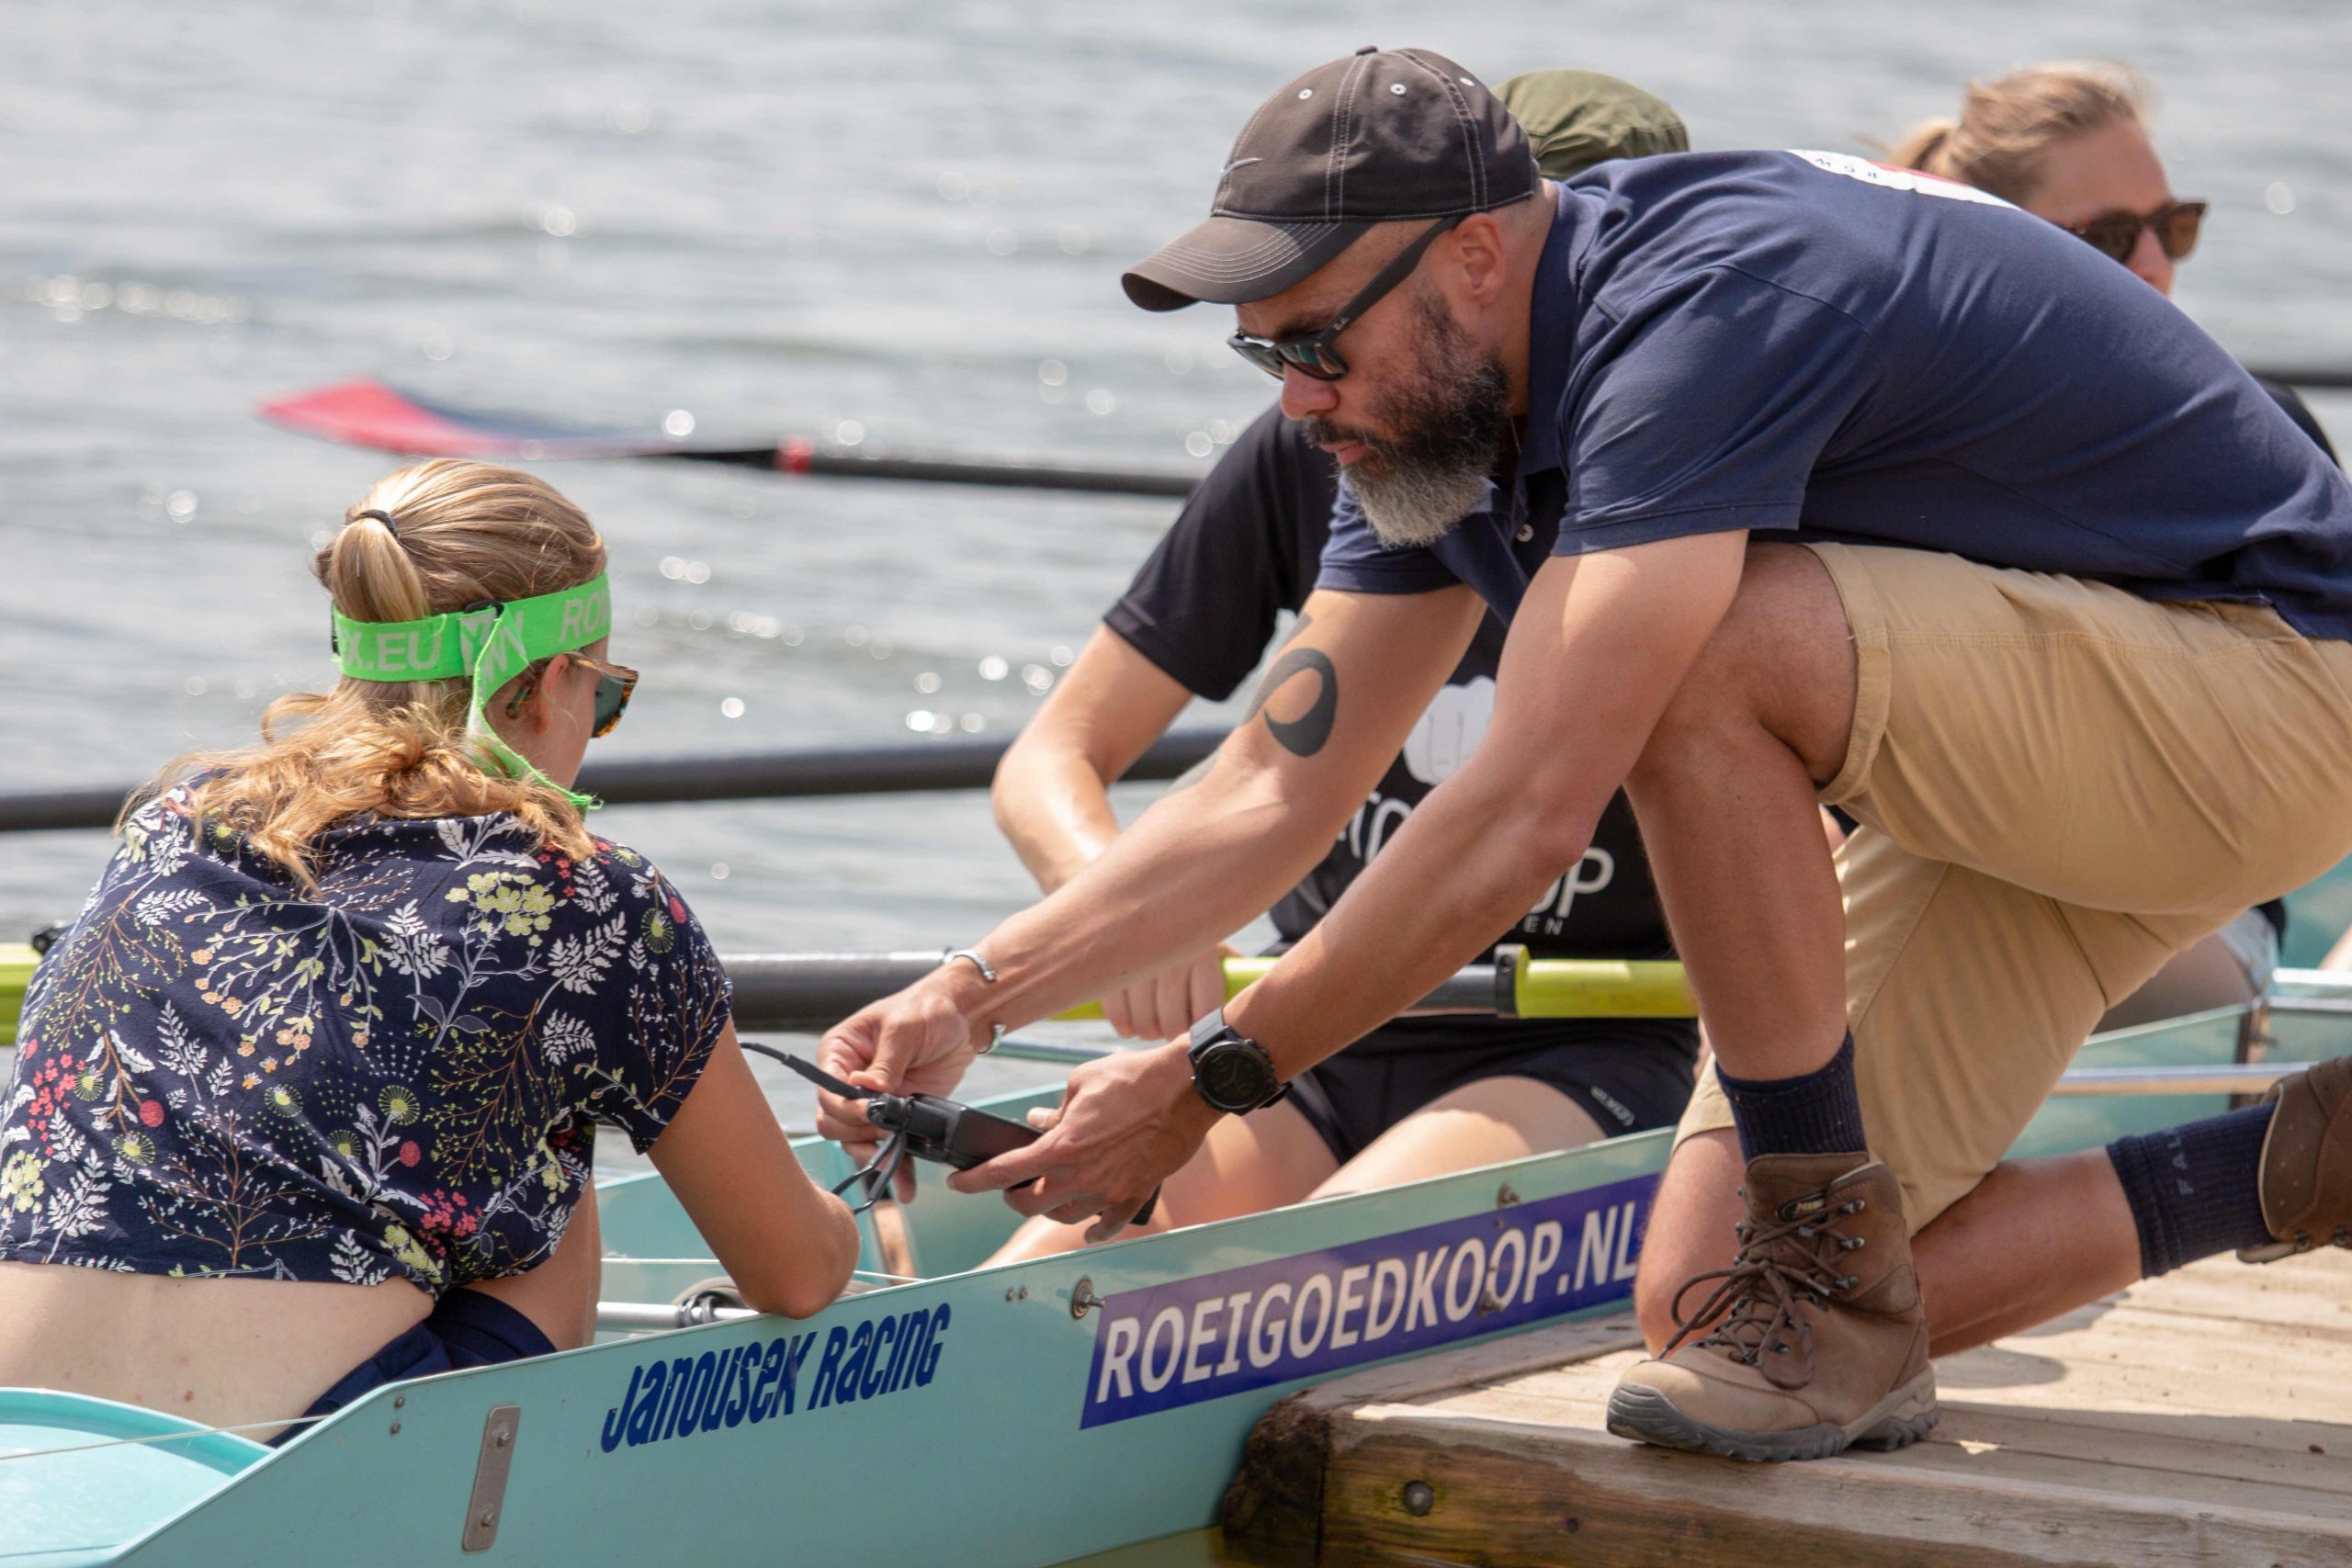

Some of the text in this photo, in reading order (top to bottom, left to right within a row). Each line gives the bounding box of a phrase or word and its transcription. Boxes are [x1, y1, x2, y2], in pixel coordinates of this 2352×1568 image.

[340, 628, 444, 671] X.EU
[2166, 1129, 2195, 1195] FAL
[1095, 1201, 1637, 1404] ROEIGOEDKOOP.NL
